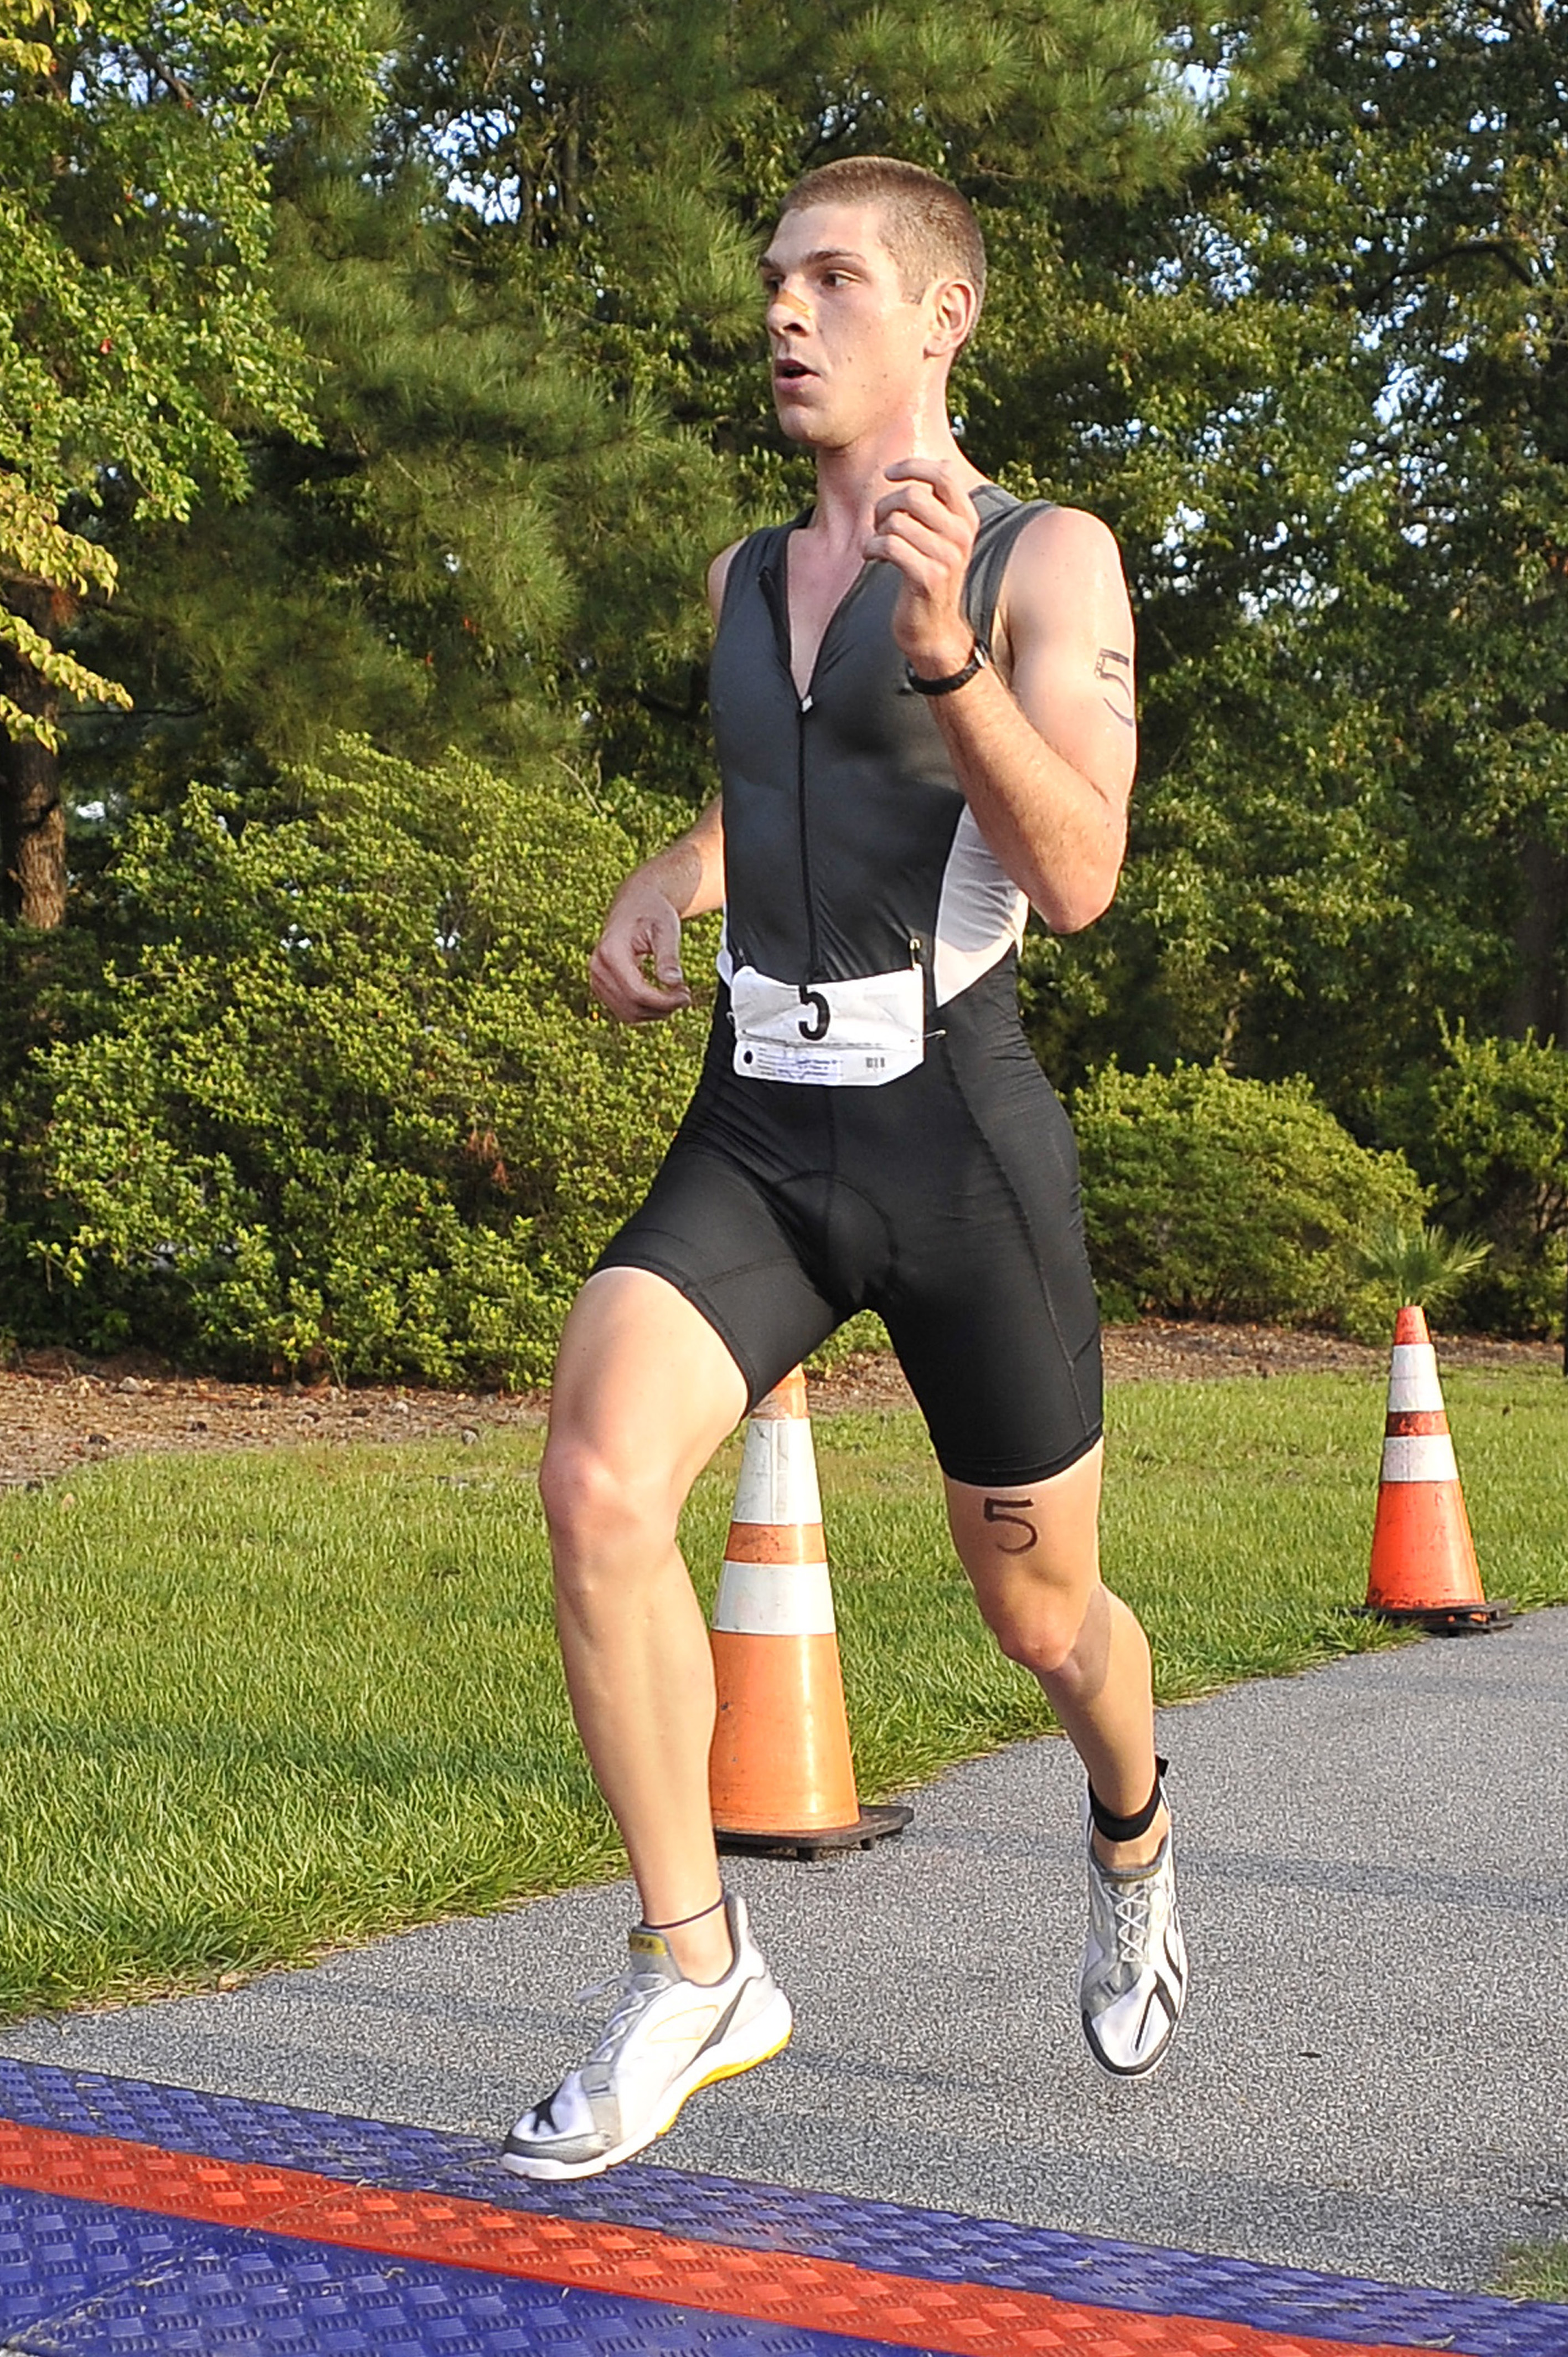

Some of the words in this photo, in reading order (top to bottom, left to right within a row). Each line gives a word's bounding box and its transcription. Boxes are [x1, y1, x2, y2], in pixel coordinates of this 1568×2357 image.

[1095, 647, 1133, 728] 5
[798, 984, 831, 1041] 5
[984, 1497, 1038, 1555] 5
